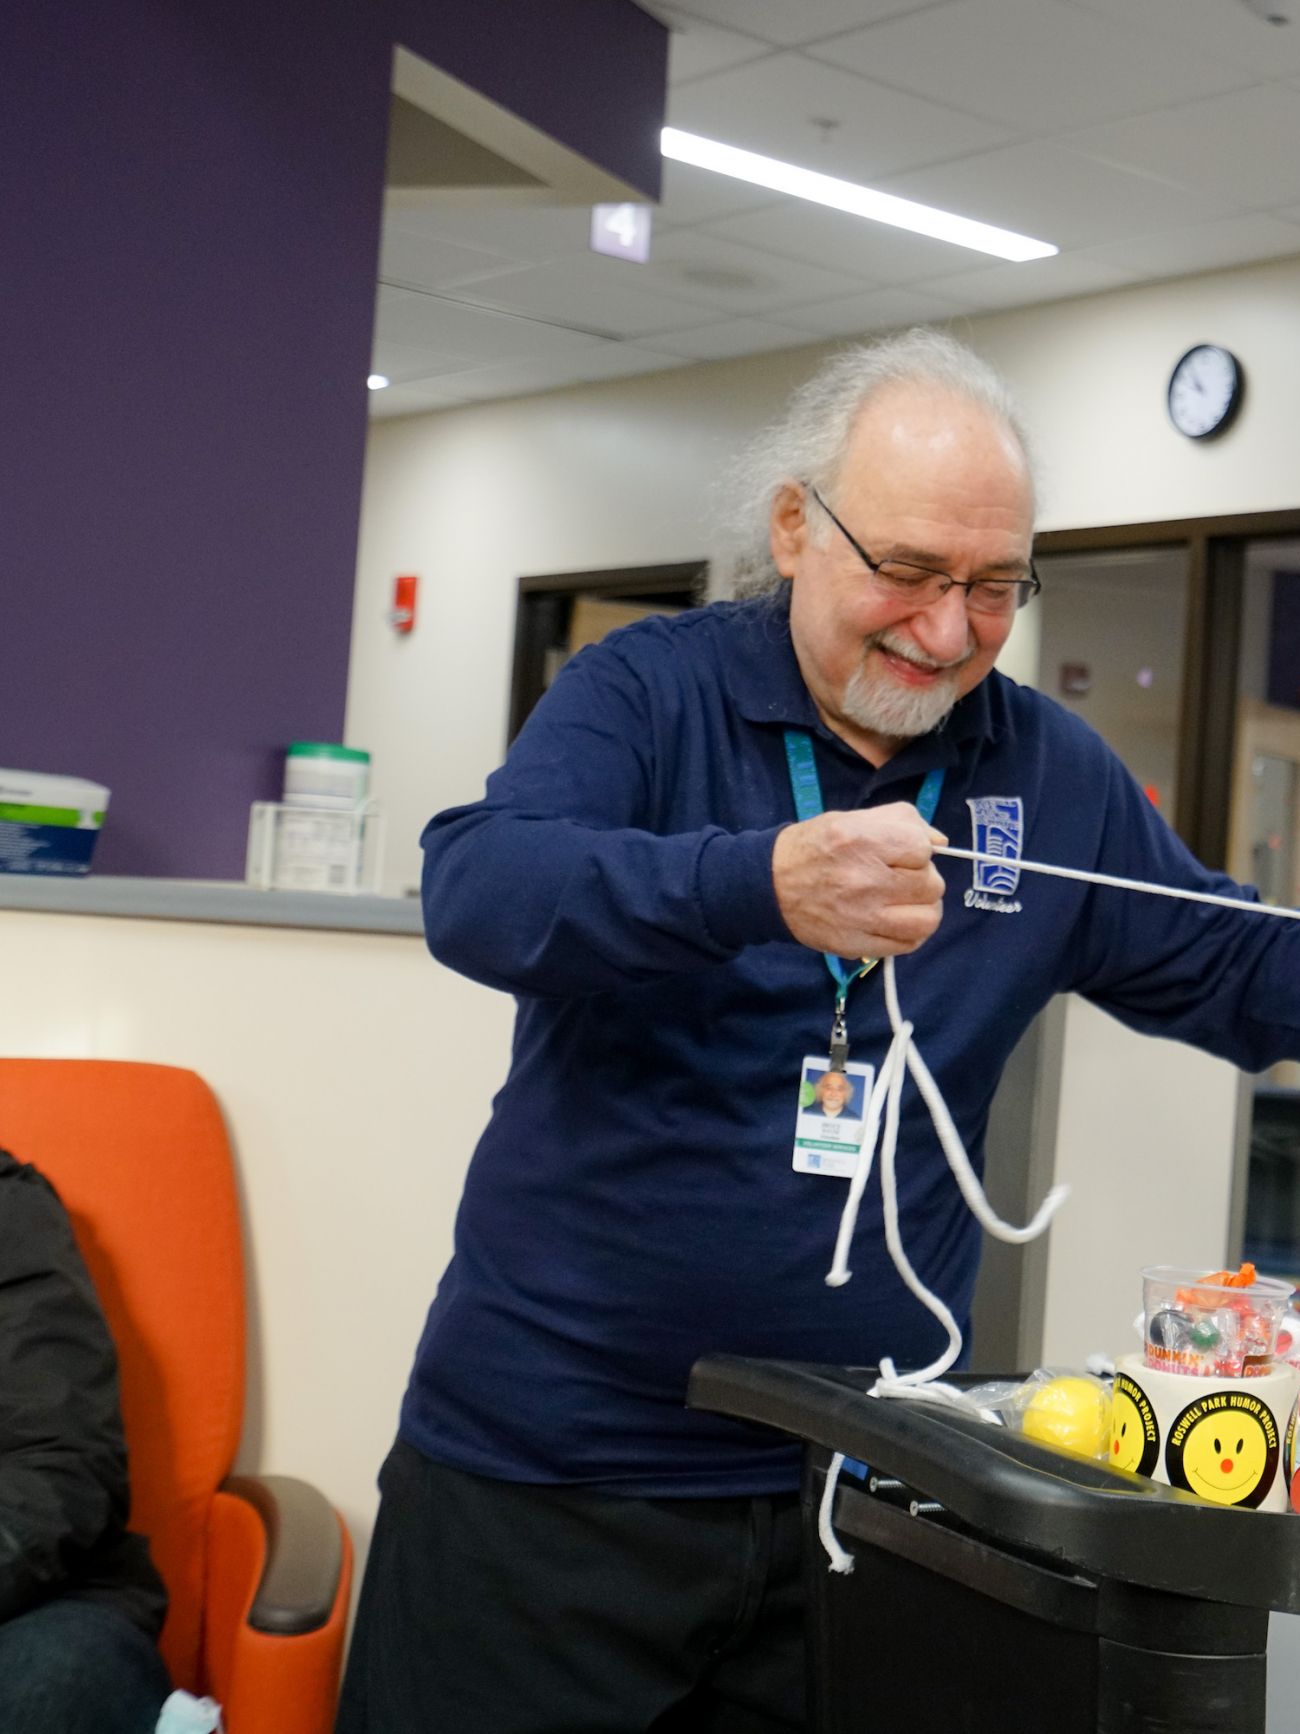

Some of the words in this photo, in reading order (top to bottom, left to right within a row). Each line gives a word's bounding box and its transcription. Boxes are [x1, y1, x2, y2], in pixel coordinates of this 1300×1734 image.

[1121, 1379, 1142, 1402] HUMOR
[1139, 1400, 1157, 1442] PROJECT
[1171, 1407, 1202, 1447] ROSWELL
[1201, 1396, 1228, 1413] PARK
[1230, 1396, 1261, 1416] HUMOR
[1260, 1410, 1278, 1449] PROJECT
